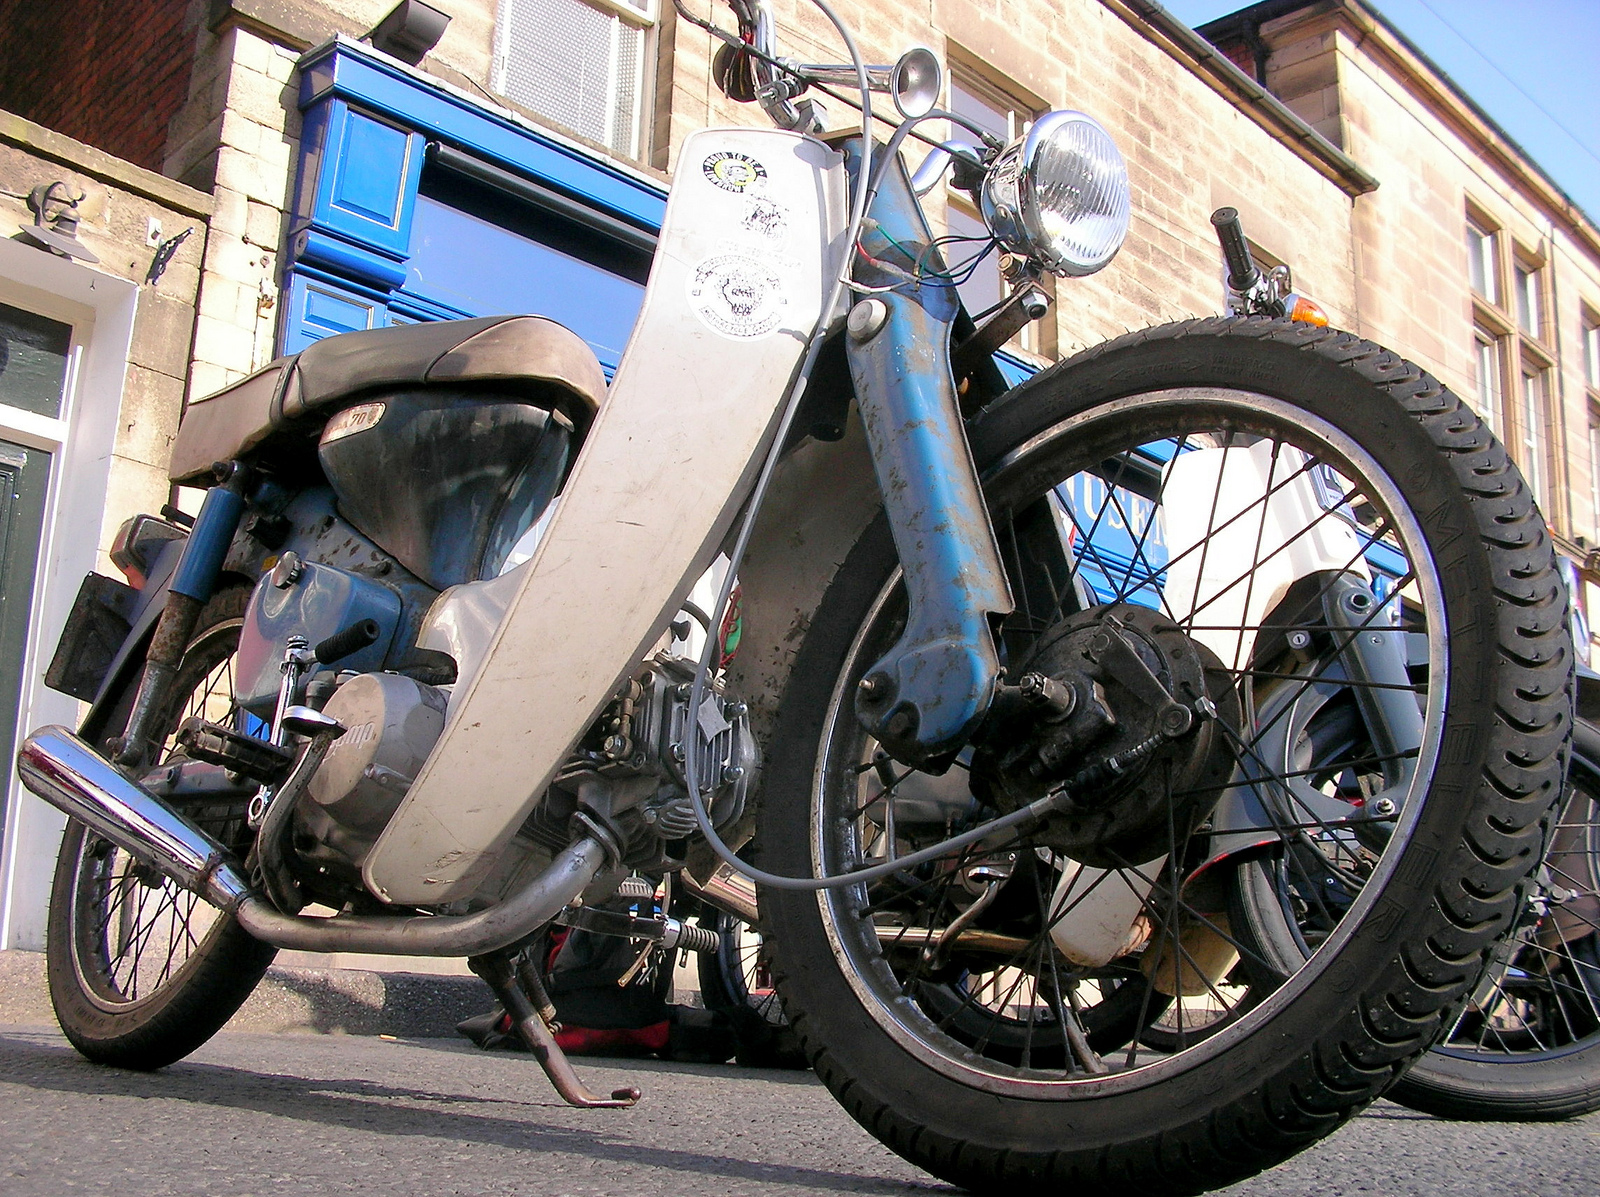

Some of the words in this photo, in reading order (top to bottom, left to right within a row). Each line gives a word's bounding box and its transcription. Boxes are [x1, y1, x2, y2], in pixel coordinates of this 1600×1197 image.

[704, 152, 729, 167] PROUD
[731, 152, 743, 160] TO
[745, 157, 759, 167] BE
[350, 411, 367, 426] 70
